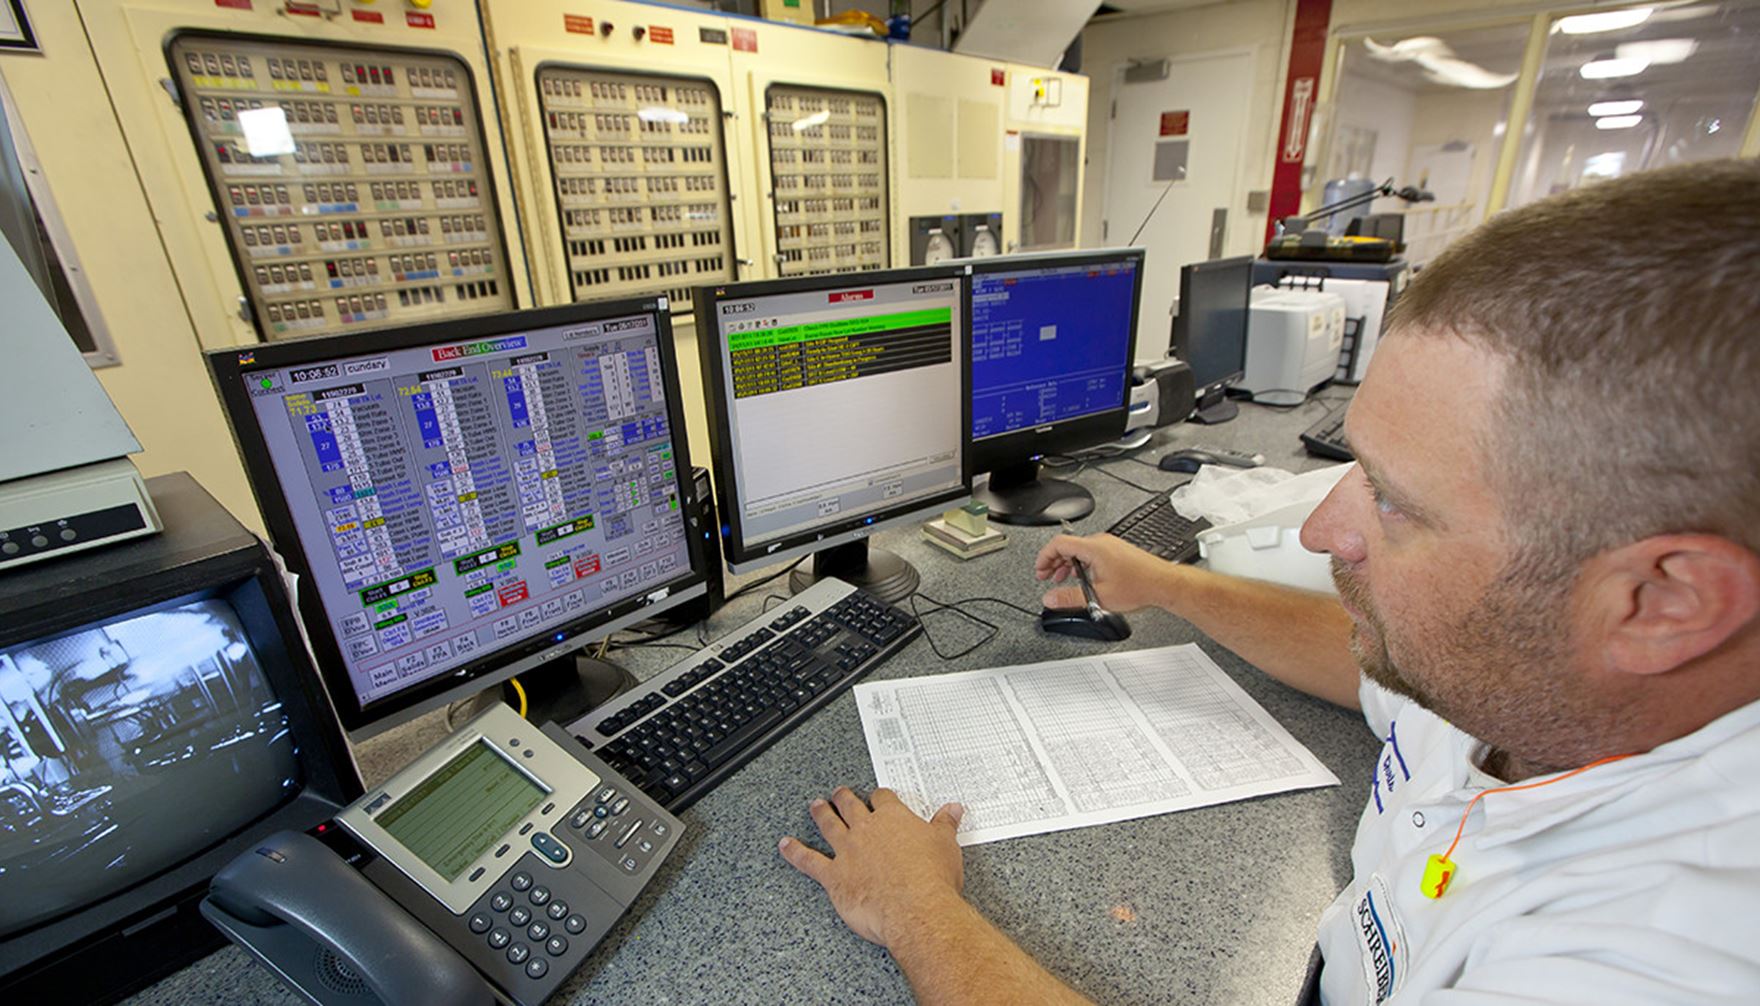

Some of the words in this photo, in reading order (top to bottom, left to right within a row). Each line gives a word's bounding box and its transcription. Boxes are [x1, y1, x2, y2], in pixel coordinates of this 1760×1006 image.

[840, 291, 863, 301] Alarms
[437, 346, 462, 359] Back
[462, 343, 481, 355] End
[373, 668, 393, 680] Main
[513, 910, 523, 918] 5
[474, 917, 483, 925] 1
[492, 932, 501, 940] 4
[511, 947, 520, 955] 7
